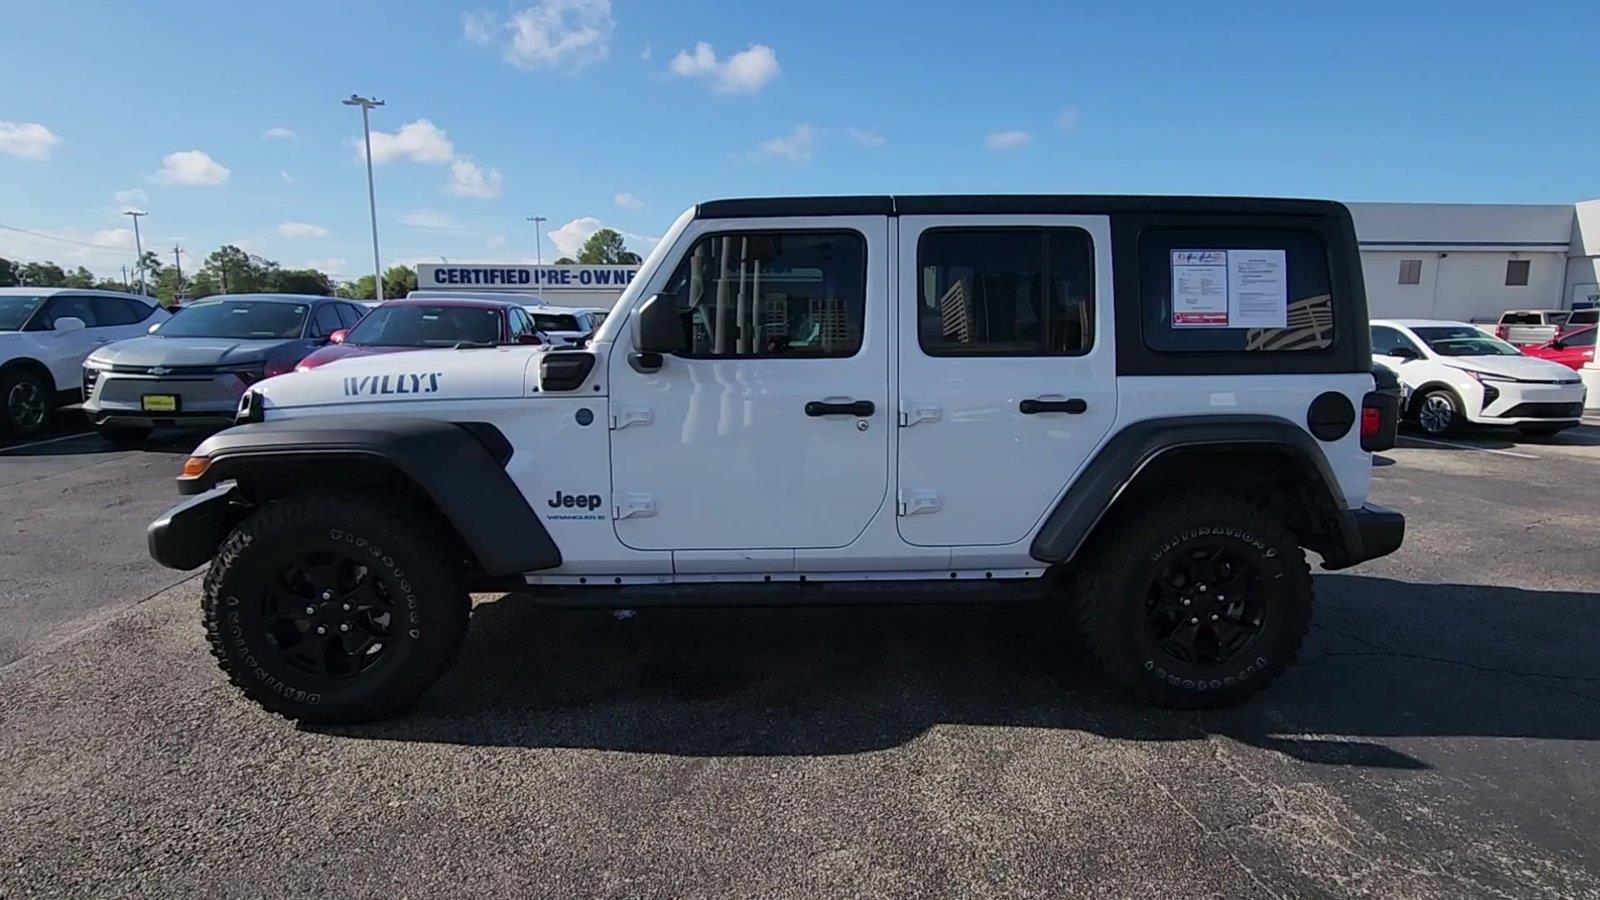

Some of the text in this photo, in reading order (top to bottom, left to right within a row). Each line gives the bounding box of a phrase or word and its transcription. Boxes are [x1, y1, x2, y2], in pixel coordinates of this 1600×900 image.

[434, 268, 530, 285] CERTIFIED
[343, 373, 442, 396] WILLYS
[548, 490, 602, 511] Jeep
